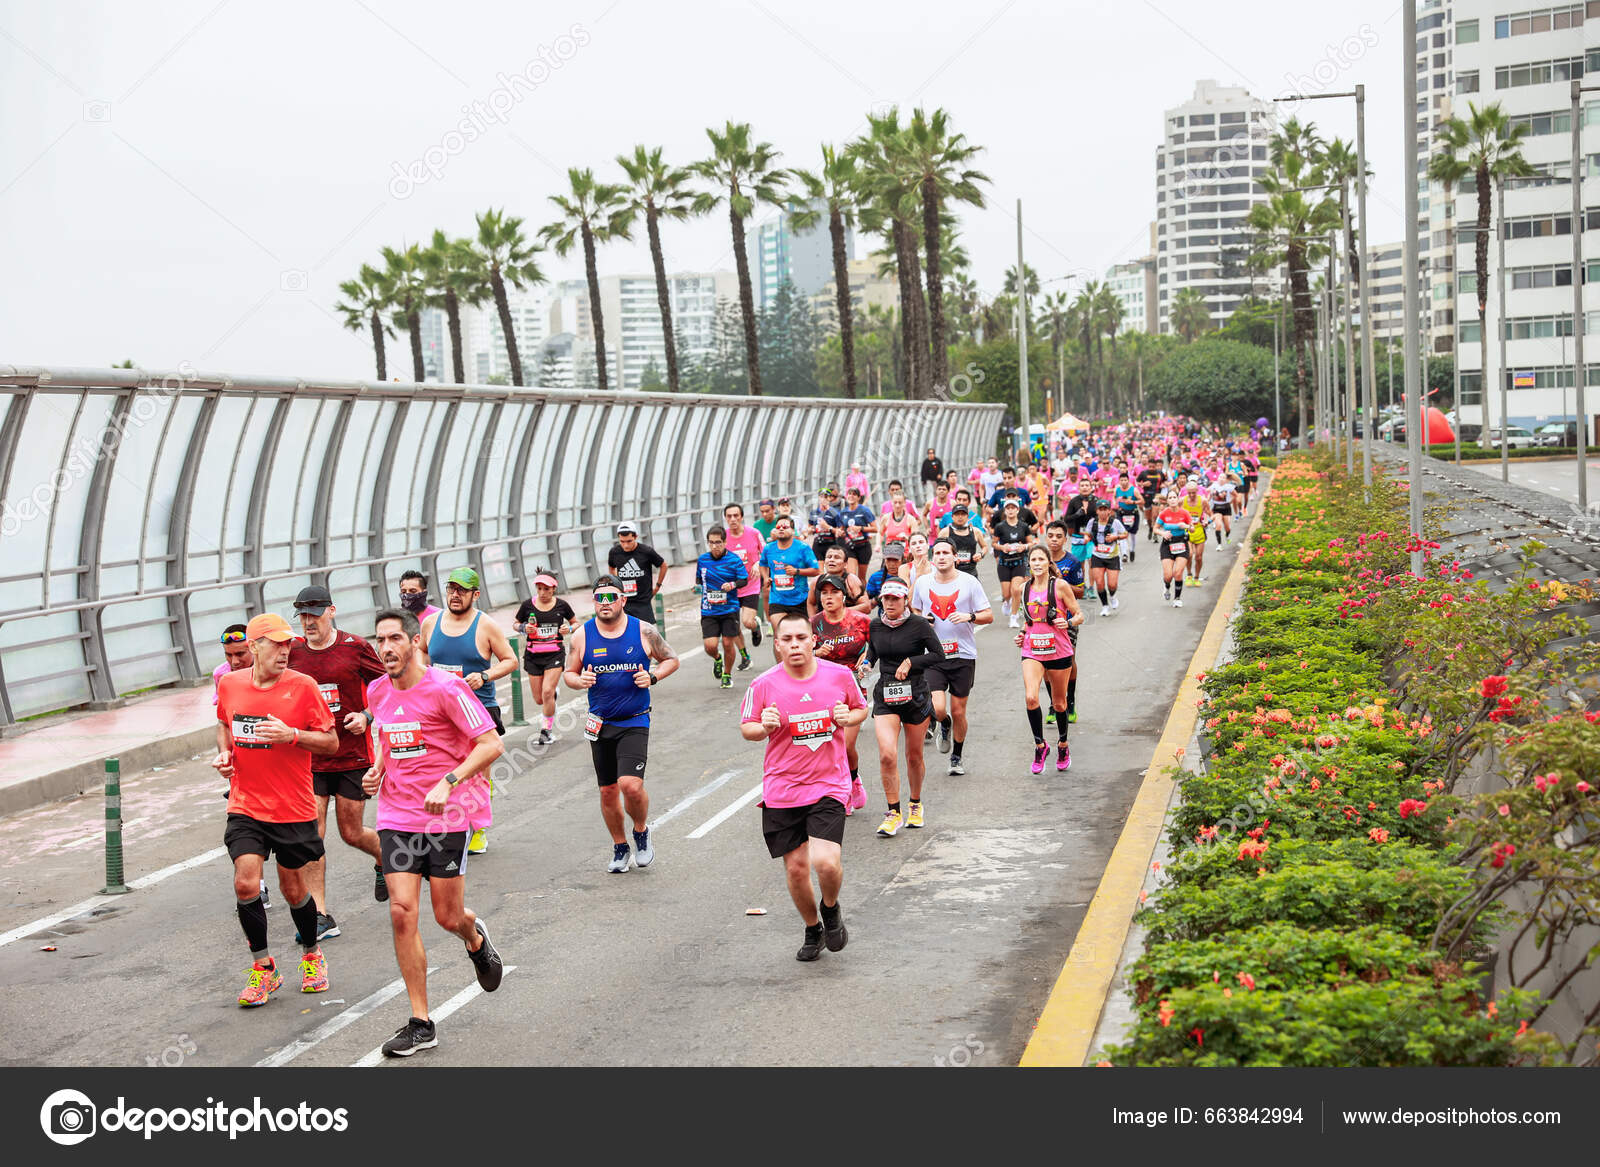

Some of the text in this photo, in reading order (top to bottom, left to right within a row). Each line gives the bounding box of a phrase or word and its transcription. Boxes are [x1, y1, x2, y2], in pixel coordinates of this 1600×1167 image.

[618, 569, 645, 578] adidas
[593, 663, 638, 672] COLOMBIA
[888, 687, 904, 696] 883
[242, 723, 255, 735] 61
[797, 720, 824, 733] 5091
[389, 731, 415, 744] 6153
